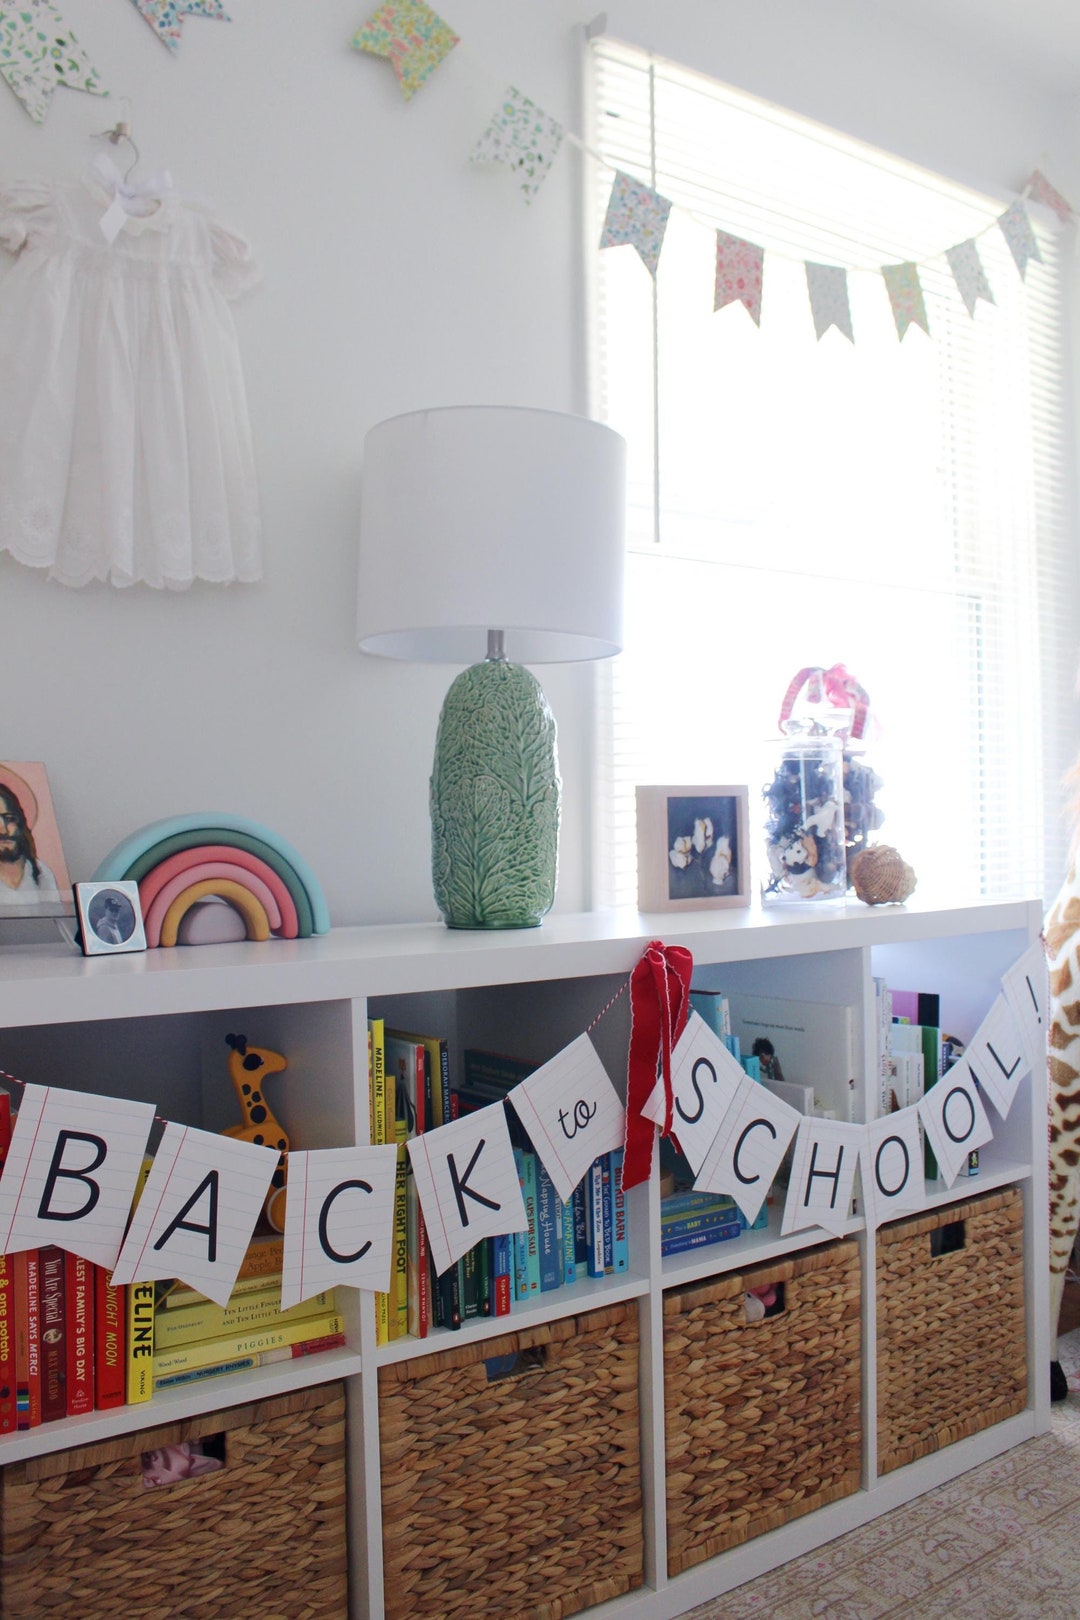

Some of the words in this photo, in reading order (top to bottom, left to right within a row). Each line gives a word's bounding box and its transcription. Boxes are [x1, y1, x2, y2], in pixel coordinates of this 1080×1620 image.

[375, 1047, 383, 1098] MADELINE
[441, 1052, 449, 1087] DEBORAH
[36, 1129, 502, 1265] BACK
[557, 1099, 598, 1140] to
[396, 1160, 406, 1190] HER
[396, 1194, 406, 1234] RIGHT
[526, 1196, 534, 1216] CAPS
[539, 1176, 550, 1222] Napping
[615, 1188, 625, 1208] RED
[527, 1216, 535, 1236] FOR
[541, 1221, 553, 1255] House
[564, 1215, 575, 1265] AMAZING!
[615, 1210, 625, 1242] BARN
[686, 1219, 702, 1230] BABY
[690, 1235, 707, 1245] MAMA
[396, 1237, 406, 1274] FOOT
[528, 1236, 536, 1257] SALE
[44, 1258, 62, 1275] You
[76, 1255, 85, 1282] LEST
[28, 1261, 38, 1313] MADELINE
[44, 1277, 61, 1292] Are
[42, 1292, 63, 1324] Special
[76, 1285, 86, 1334] FAMILY'S
[133, 1284, 152, 1359] ELINE
[29, 1317, 38, 1340] SAYS
[236, 1334, 284, 1352] PIGGIES
[29, 1343, 38, 1376] MERCI
[76, 1336, 86, 1356] BIG
[105, 1331, 118, 1367] MOON
[76, 1359, 86, 1382] DAY
